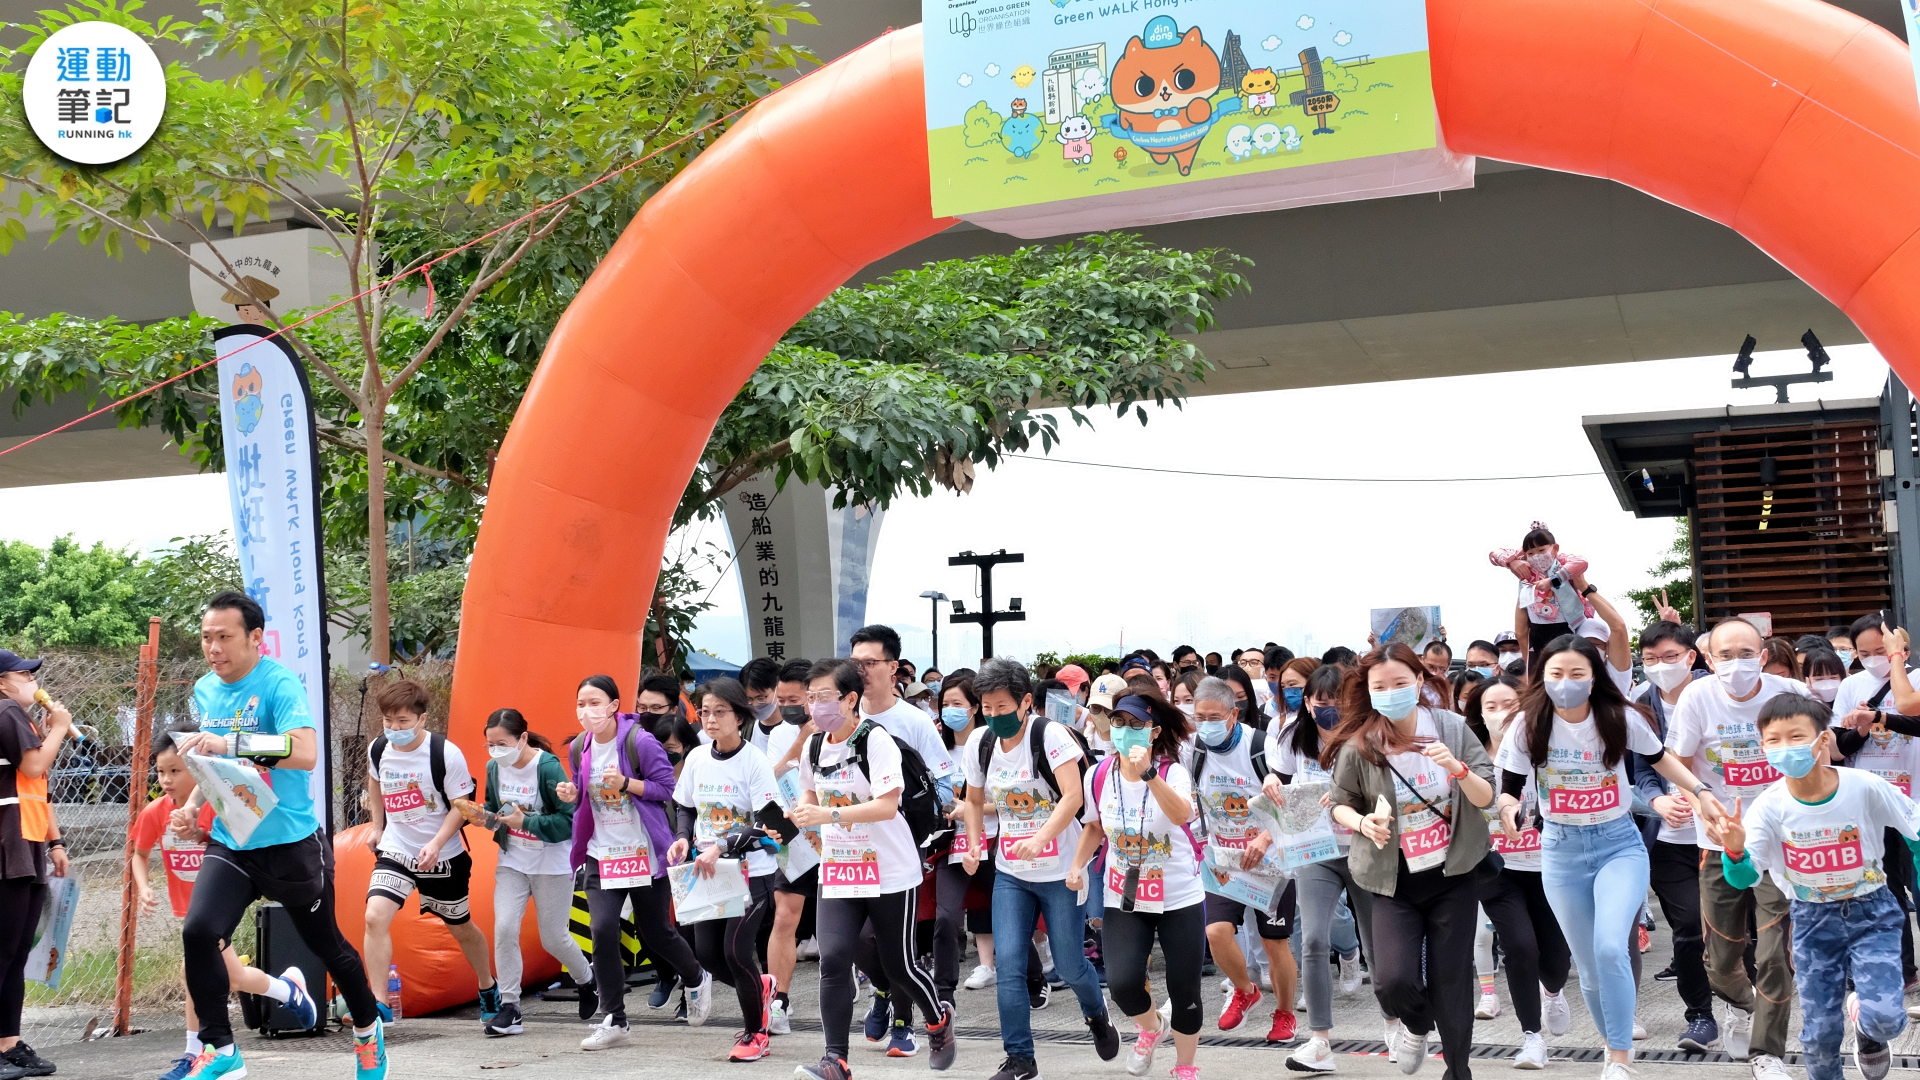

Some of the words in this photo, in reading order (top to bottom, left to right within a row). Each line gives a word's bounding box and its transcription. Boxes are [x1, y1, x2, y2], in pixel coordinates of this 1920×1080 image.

[948, 1, 977, 9] Organiser
[978, 6, 1003, 16] WORLD
[1006, 1, 1030, 11] GREEN
[1054, 10, 1094, 25] Green
[1099, 3, 1139, 18] WALK
[1144, 0, 1179, 9] Hong
[978, 9, 1030, 23] ORGANISATION
[978, 17, 1030, 34] 世界綠色組織
[1154, 25, 1170, 34] din
[1150, 31, 1173, 42] dong
[748, 492, 786, 662] 造船業的九龍東
[199, 712, 235, 728] ANCHOR
[237, 716, 259, 727] RUN
[384, 793, 420, 810] F425C
[1554, 790, 1615, 809] F422D
[1405, 823, 1451, 853] F422
[1786, 847, 1857, 870] F201B
[603, 859, 648, 876] F432A
[826, 865, 876, 882] F401A
[1111, 873, 1160, 898] F41C
